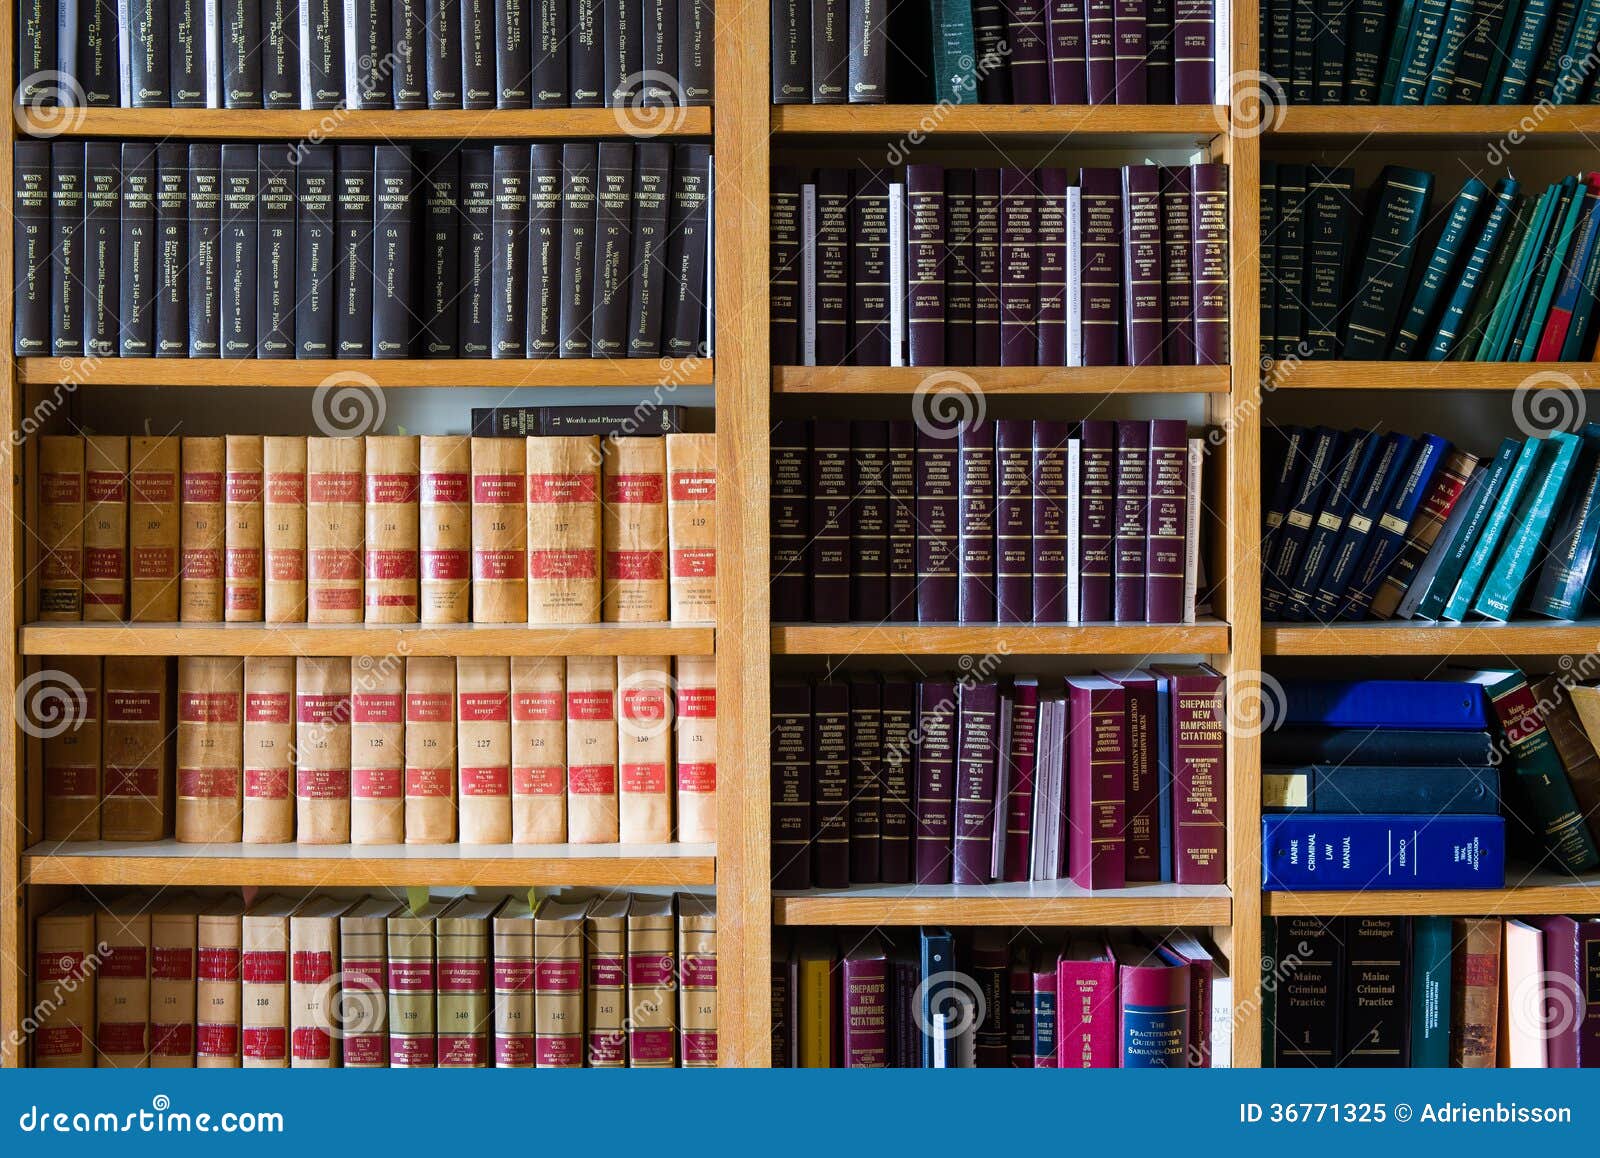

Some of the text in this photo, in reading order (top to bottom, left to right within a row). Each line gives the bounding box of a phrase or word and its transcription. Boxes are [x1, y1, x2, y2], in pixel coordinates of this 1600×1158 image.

[825, 13, 834, 41] Estoppel
[863, 21, 871, 57] Franchises
[27, 226, 37, 234] 5B
[132, 228, 143, 236] 6A
[272, 243, 280, 277] Negligence
[311, 243, 319, 272] Pleading
[164, 241, 172, 287] Employment
[234, 270, 242, 306] Negligence
[492, 522, 506, 531] 116
[692, 518, 706, 527] 119
[1180, 700, 1222, 709] SHEPARD'S
[1192, 711, 1211, 719] NEW
[1180, 721, 1222, 730] HAMPSHIRE
[1181, 732, 1222, 740] CITATIONS
[370, 739, 383, 747] 125
[423, 739, 437, 747] 126
[476, 739, 491, 748] 127
[531, 739, 544, 747] 128
[1542, 774, 1551, 785] 1
[1133, 826, 1149, 834] 2014
[1290, 839, 1298, 865] MAINE
[1308, 833, 1316, 871] CRIMINAL
[1325, 843, 1333, 860] LAW
[1343, 836, 1351, 869] MANUAL
[1292, 920, 1323, 929] Cluchey
[1362, 920, 1391, 929] Cluchey
[1289, 928, 1325, 937] Seitzinger
[1358, 928, 1394, 937] Seitzinger
[1294, 972, 1322, 982] Maine
[1362, 972, 1390, 982] Maine
[850, 985, 885, 993] SHEPARD'S
[1287, 985, 1327, 995] Criminal
[1357, 984, 1395, 995] Criminal
[257, 998, 269, 1006] 136
[861, 996, 875, 1004] NEW
[1289, 998, 1325, 1008] Practice
[1358, 998, 1393, 1007] Practice
[850, 1006, 885, 1014] HAMPSHIRE
[850, 1016, 885, 1025] CITATIONS
[1303, 1031, 1310, 1043] 1
[1371, 1030, 1380, 1043] 2
